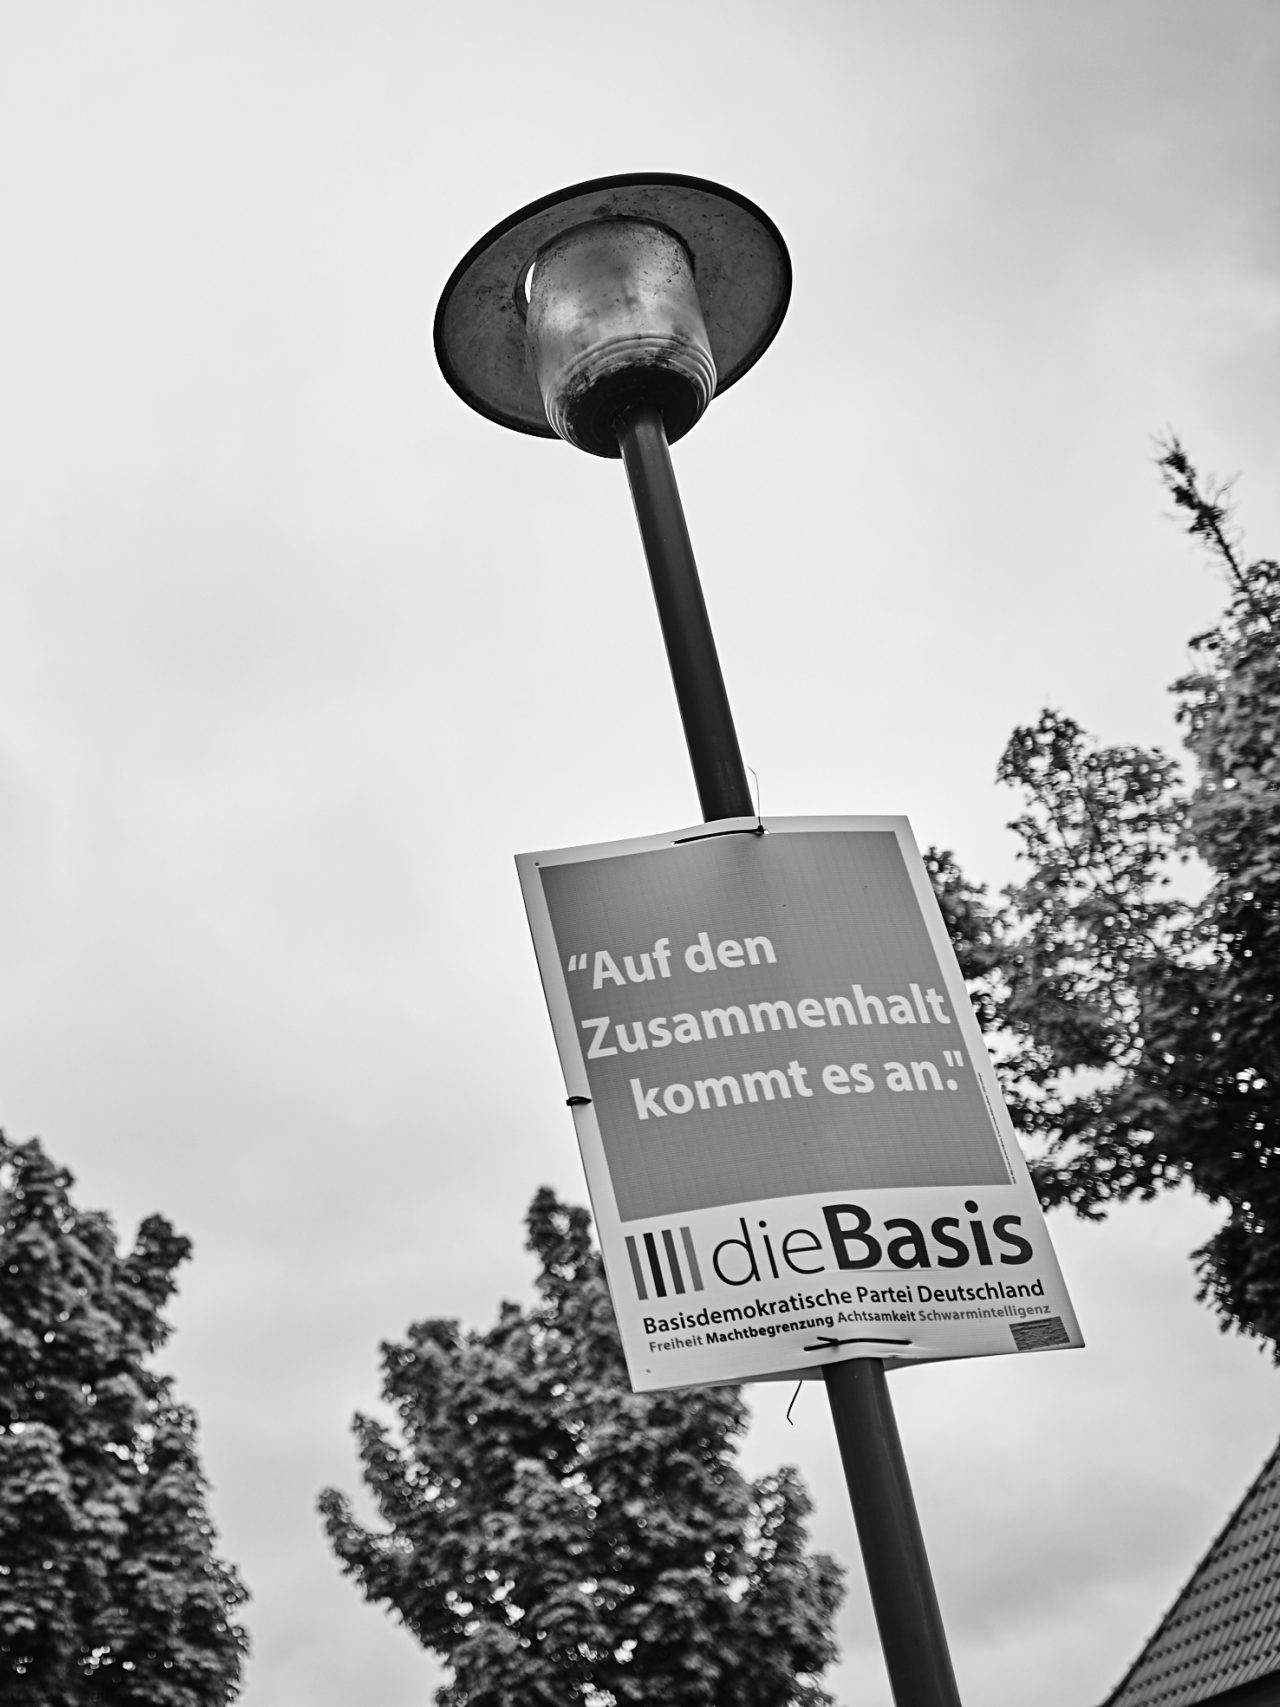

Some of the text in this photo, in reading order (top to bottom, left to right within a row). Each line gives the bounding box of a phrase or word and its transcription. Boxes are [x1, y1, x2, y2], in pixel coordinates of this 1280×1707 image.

[567, 931, 777, 990] “Auf den
[581, 983, 951, 1060] Zusammenhalt
[630, 1050, 965, 1121] kommt es an."
[643, 1279, 1045, 1335] Basisdemokratische Partei Deutschland
[649, 1303, 1052, 1353] Freiheit Machtbegrenzung Achtsamkeit Schwarmintelligenz
